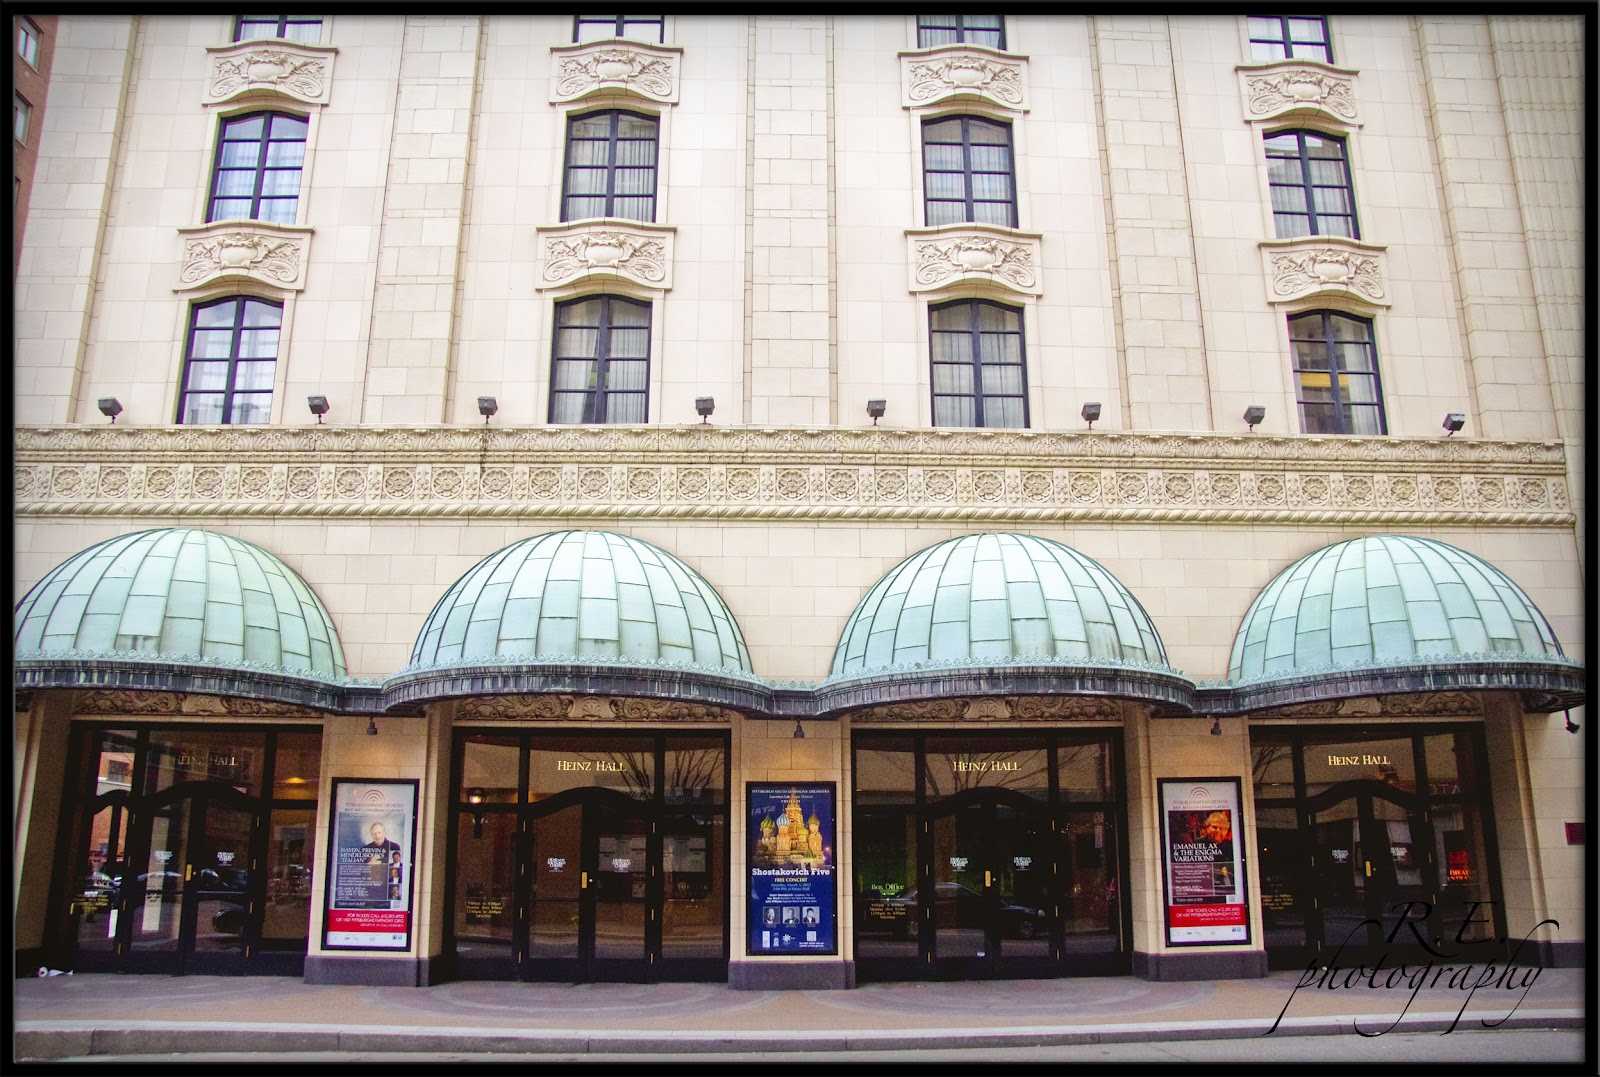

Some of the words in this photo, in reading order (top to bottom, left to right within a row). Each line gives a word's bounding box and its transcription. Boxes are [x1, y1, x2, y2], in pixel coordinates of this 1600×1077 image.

[208, 755, 238, 766] HALL
[557, 760, 592, 771] HEINZ
[596, 760, 627, 772] HALL
[953, 761, 987, 772] HEINZ
[991, 760, 1021, 771] HALL
[1327, 755, 1360, 766] HEINZ
[1362, 754, 1391, 765] HALL
[752, 868, 809, 876] Shostakovich
[811, 868, 830, 876] Five
